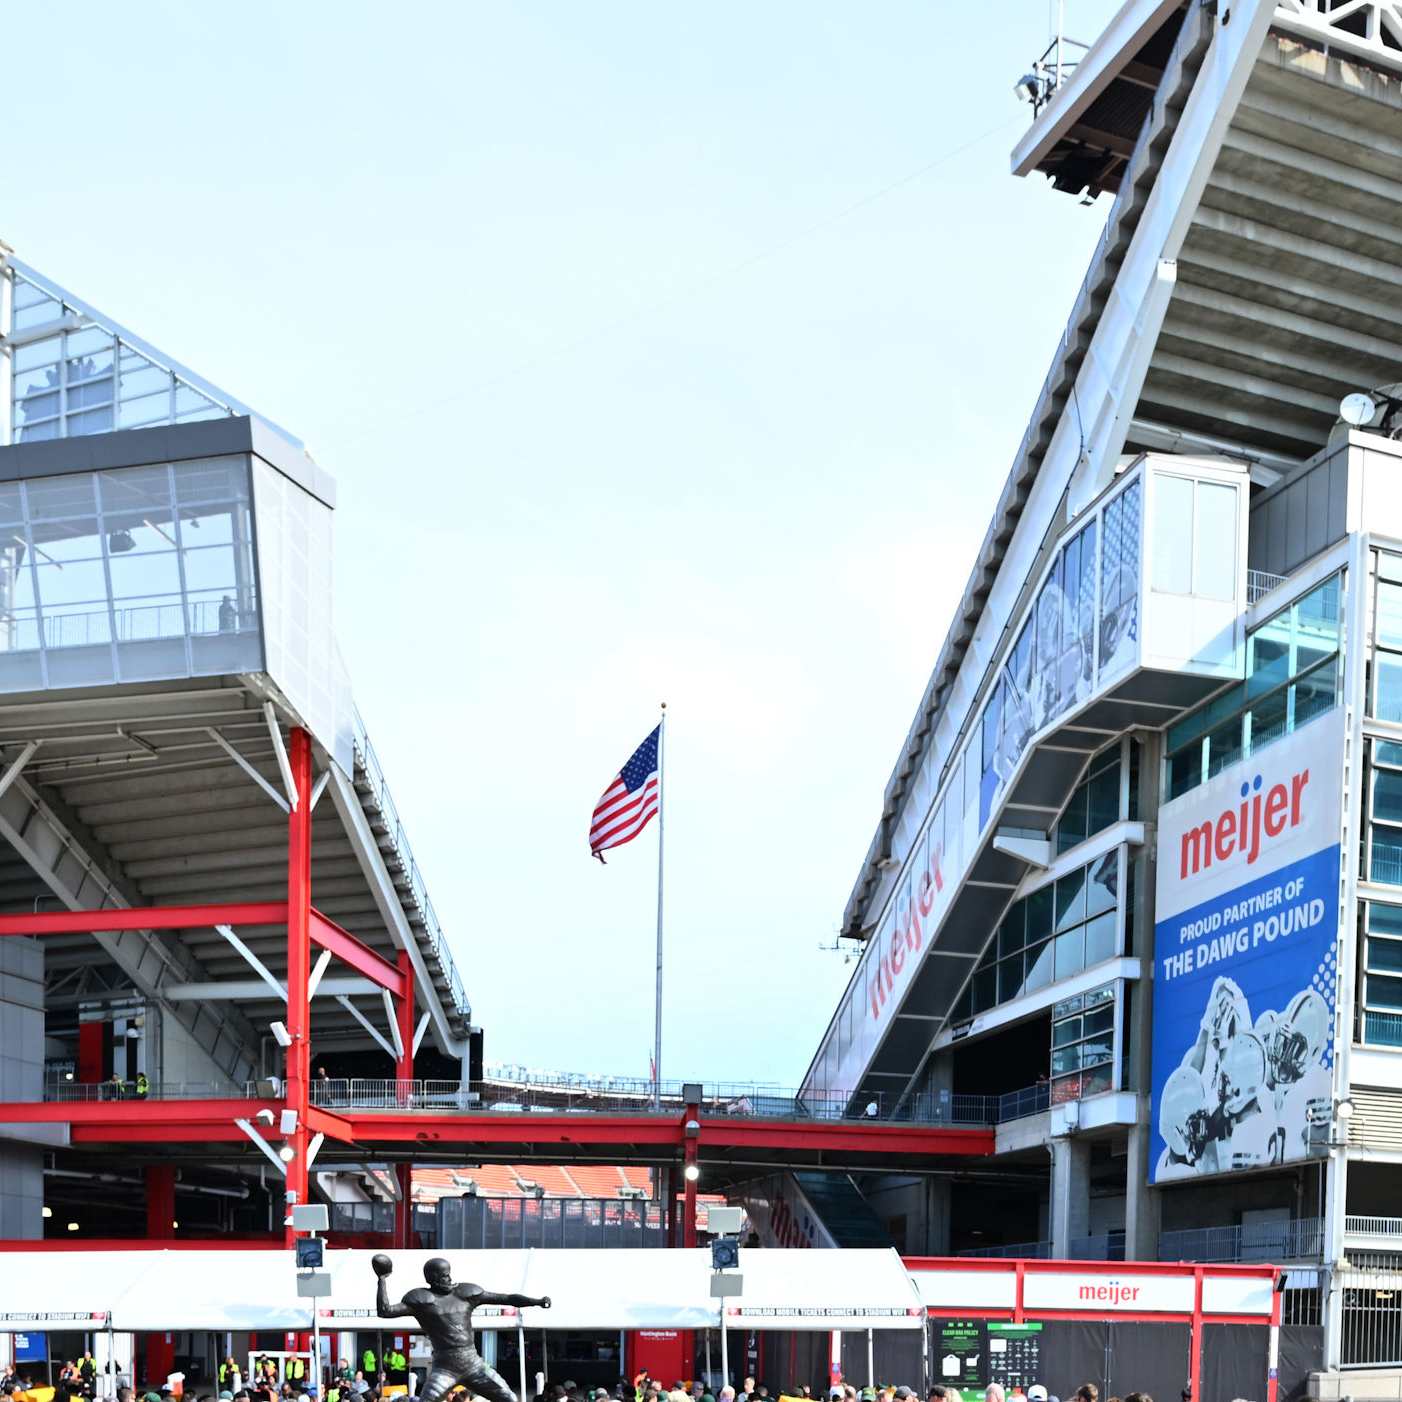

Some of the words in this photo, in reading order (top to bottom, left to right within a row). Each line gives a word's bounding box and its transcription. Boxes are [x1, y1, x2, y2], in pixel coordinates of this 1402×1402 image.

[1180, 768, 1309, 880] meijer
[868, 842, 946, 1020] meijer
[1163, 951, 1193, 981] THE
[1196, 928, 1249, 970] DAWG
[1253, 898, 1325, 946] POUND
[1180, 909, 1221, 944] PROUD
[1223, 885, 1282, 927] PARTNER
[1286, 875, 1305, 902] OF
[1079, 1281, 1140, 1304] meijer
